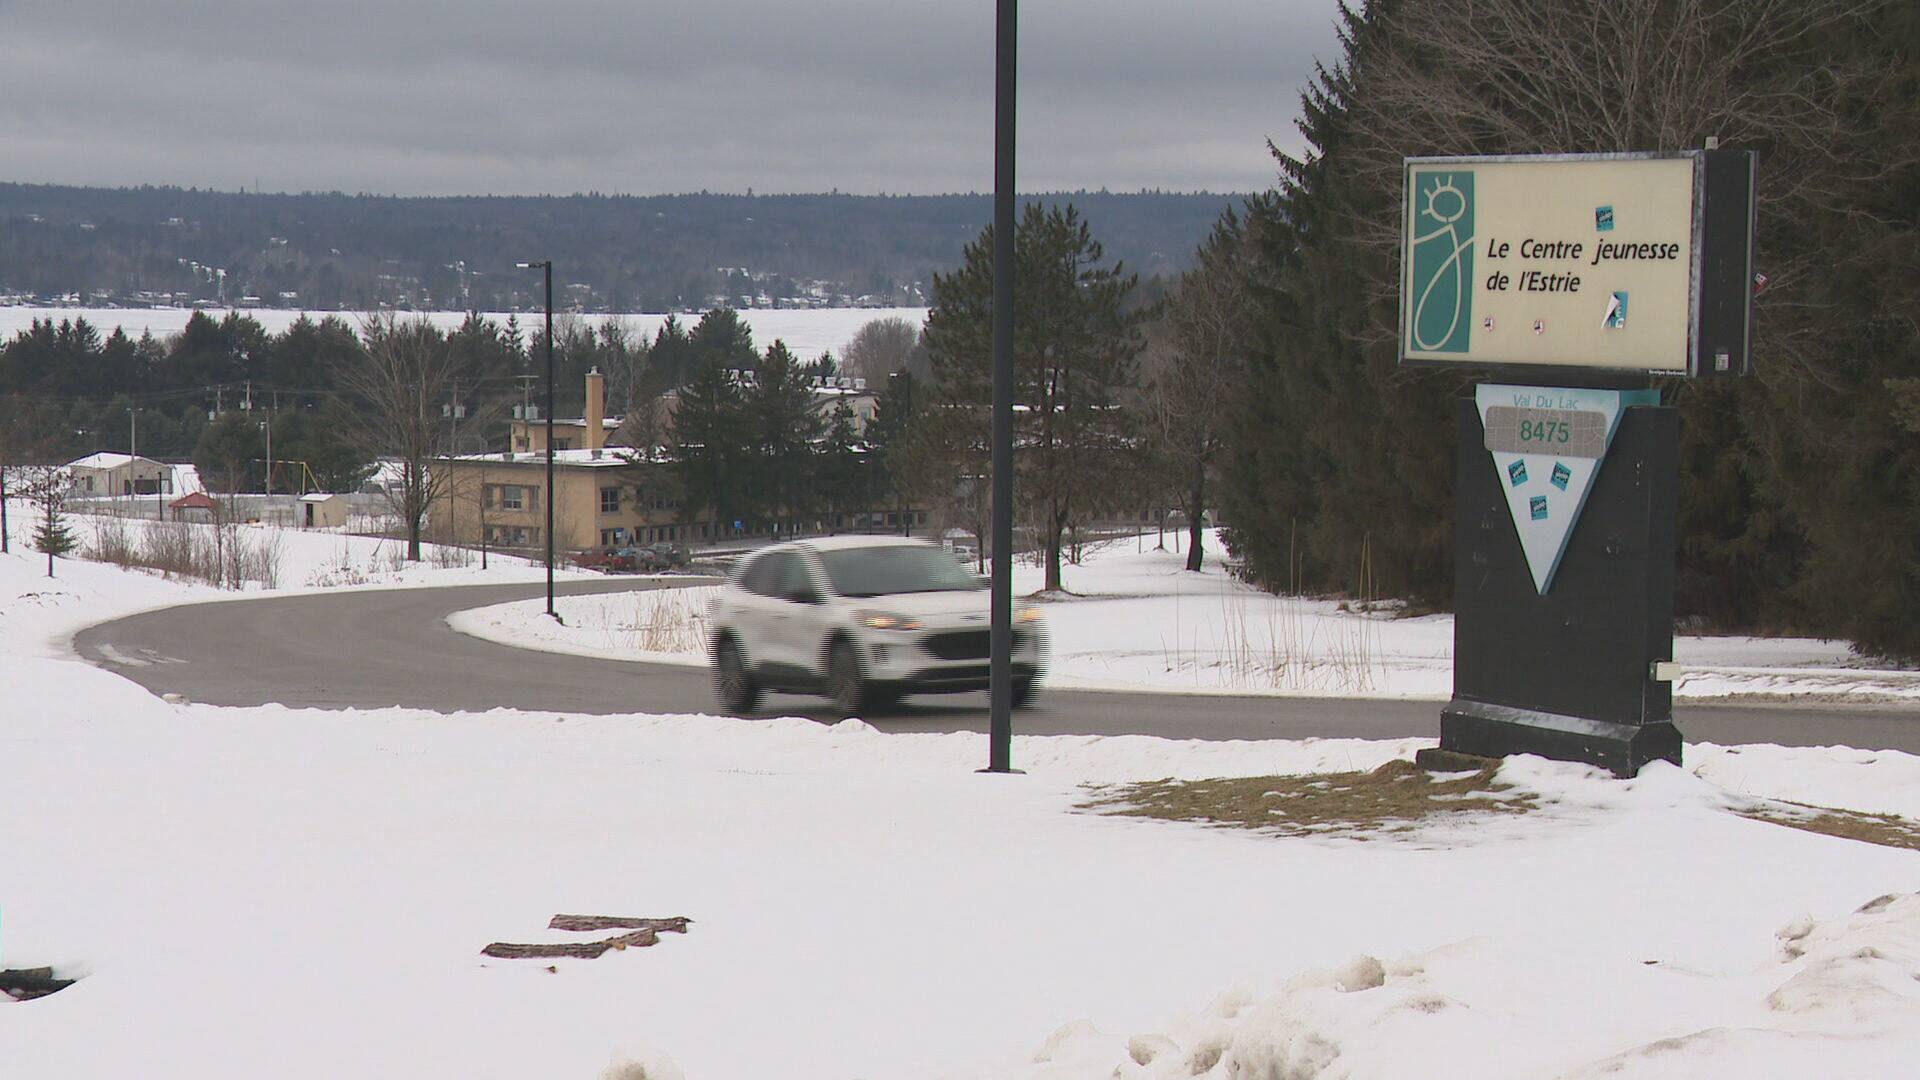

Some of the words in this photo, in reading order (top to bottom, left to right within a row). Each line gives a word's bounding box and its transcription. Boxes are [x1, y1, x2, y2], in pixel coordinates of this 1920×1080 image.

[1487, 238, 1510, 259] Le
[1520, 238, 1583, 260] Centre
[1591, 238, 1680, 266] jeunesse
[1486, 271, 1509, 291] de
[1518, 271, 1581, 292] l'Estrie
[1513, 393, 1531, 407] Val
[1536, 395, 1553, 408] Du
[1559, 396, 1579, 409] Lac
[1520, 420, 1569, 443] 8475
